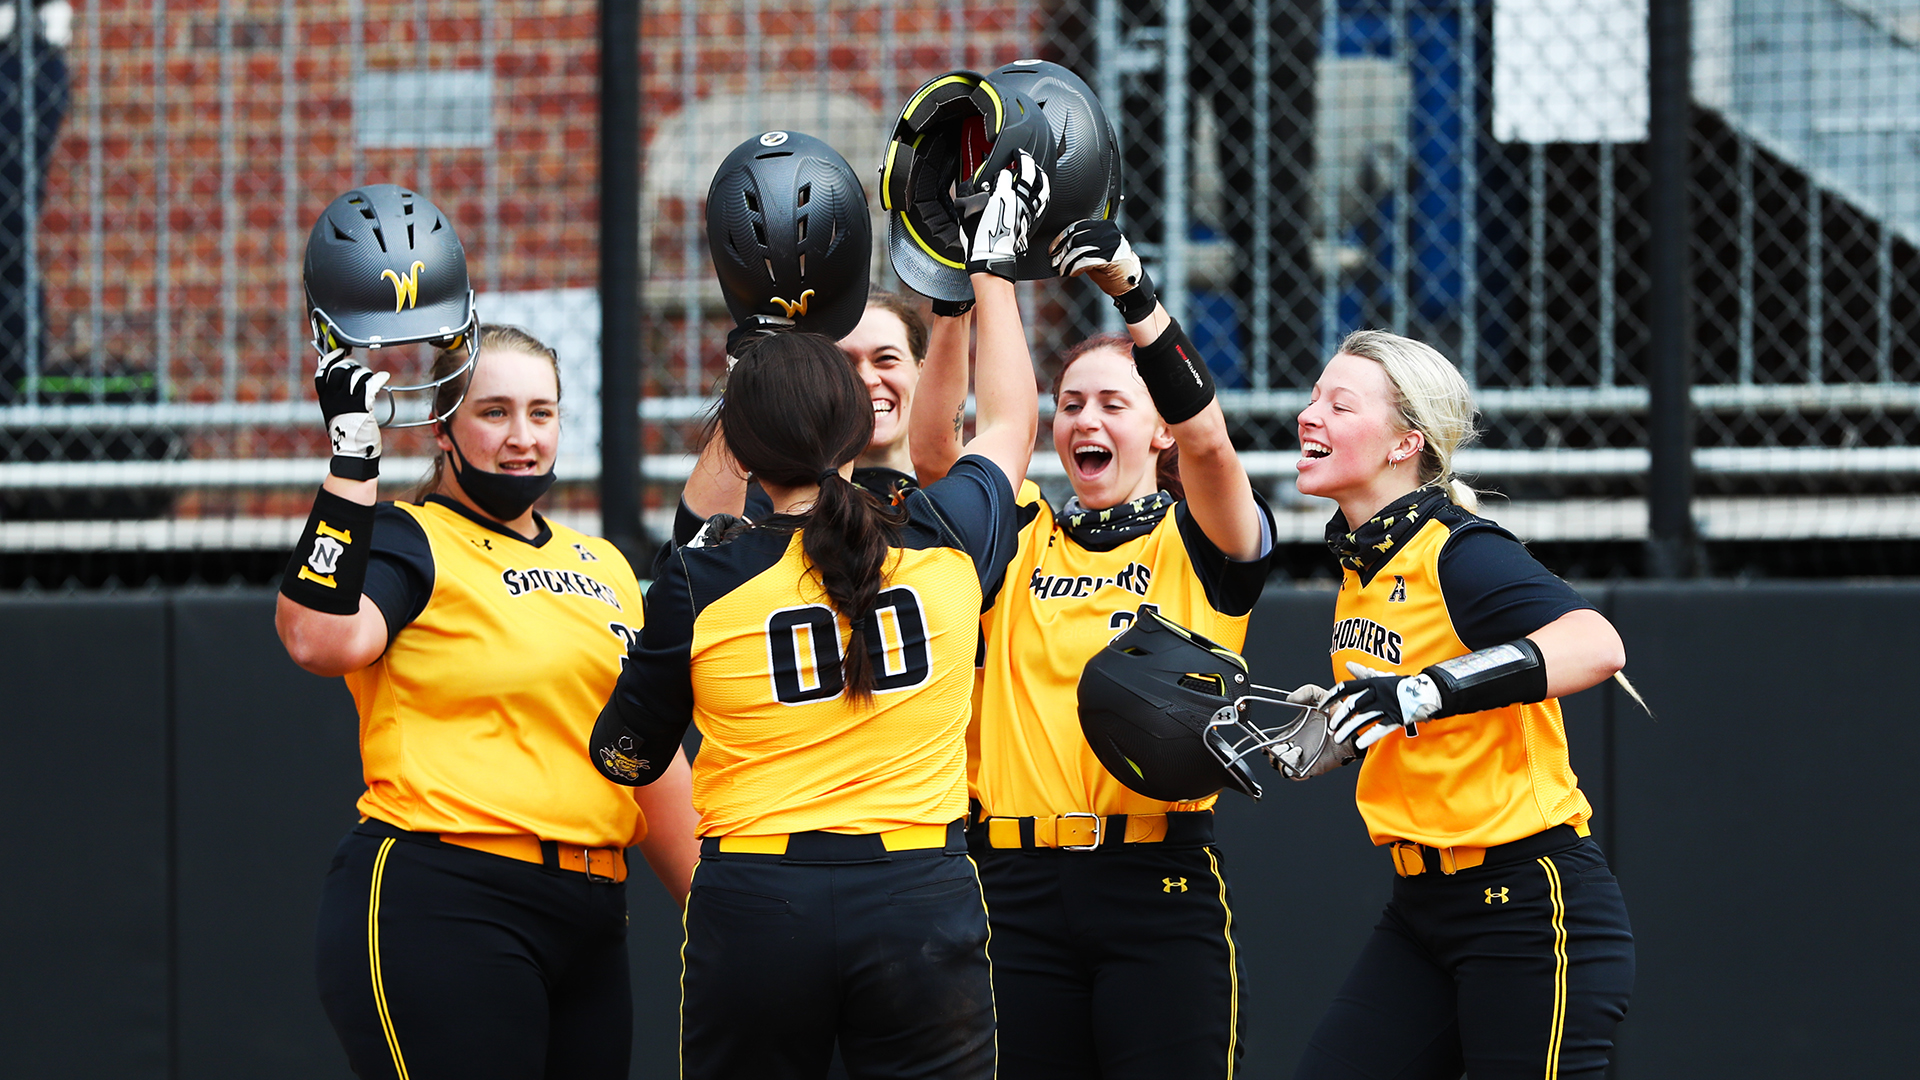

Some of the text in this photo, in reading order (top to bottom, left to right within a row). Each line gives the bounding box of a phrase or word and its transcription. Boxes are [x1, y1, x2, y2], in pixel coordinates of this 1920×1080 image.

[381, 261, 425, 313] W
[770, 289, 815, 318] W
[1388, 575, 1407, 602] A
[765, 584, 933, 707] 00
[1329, 616, 1403, 666] HOCKERS
